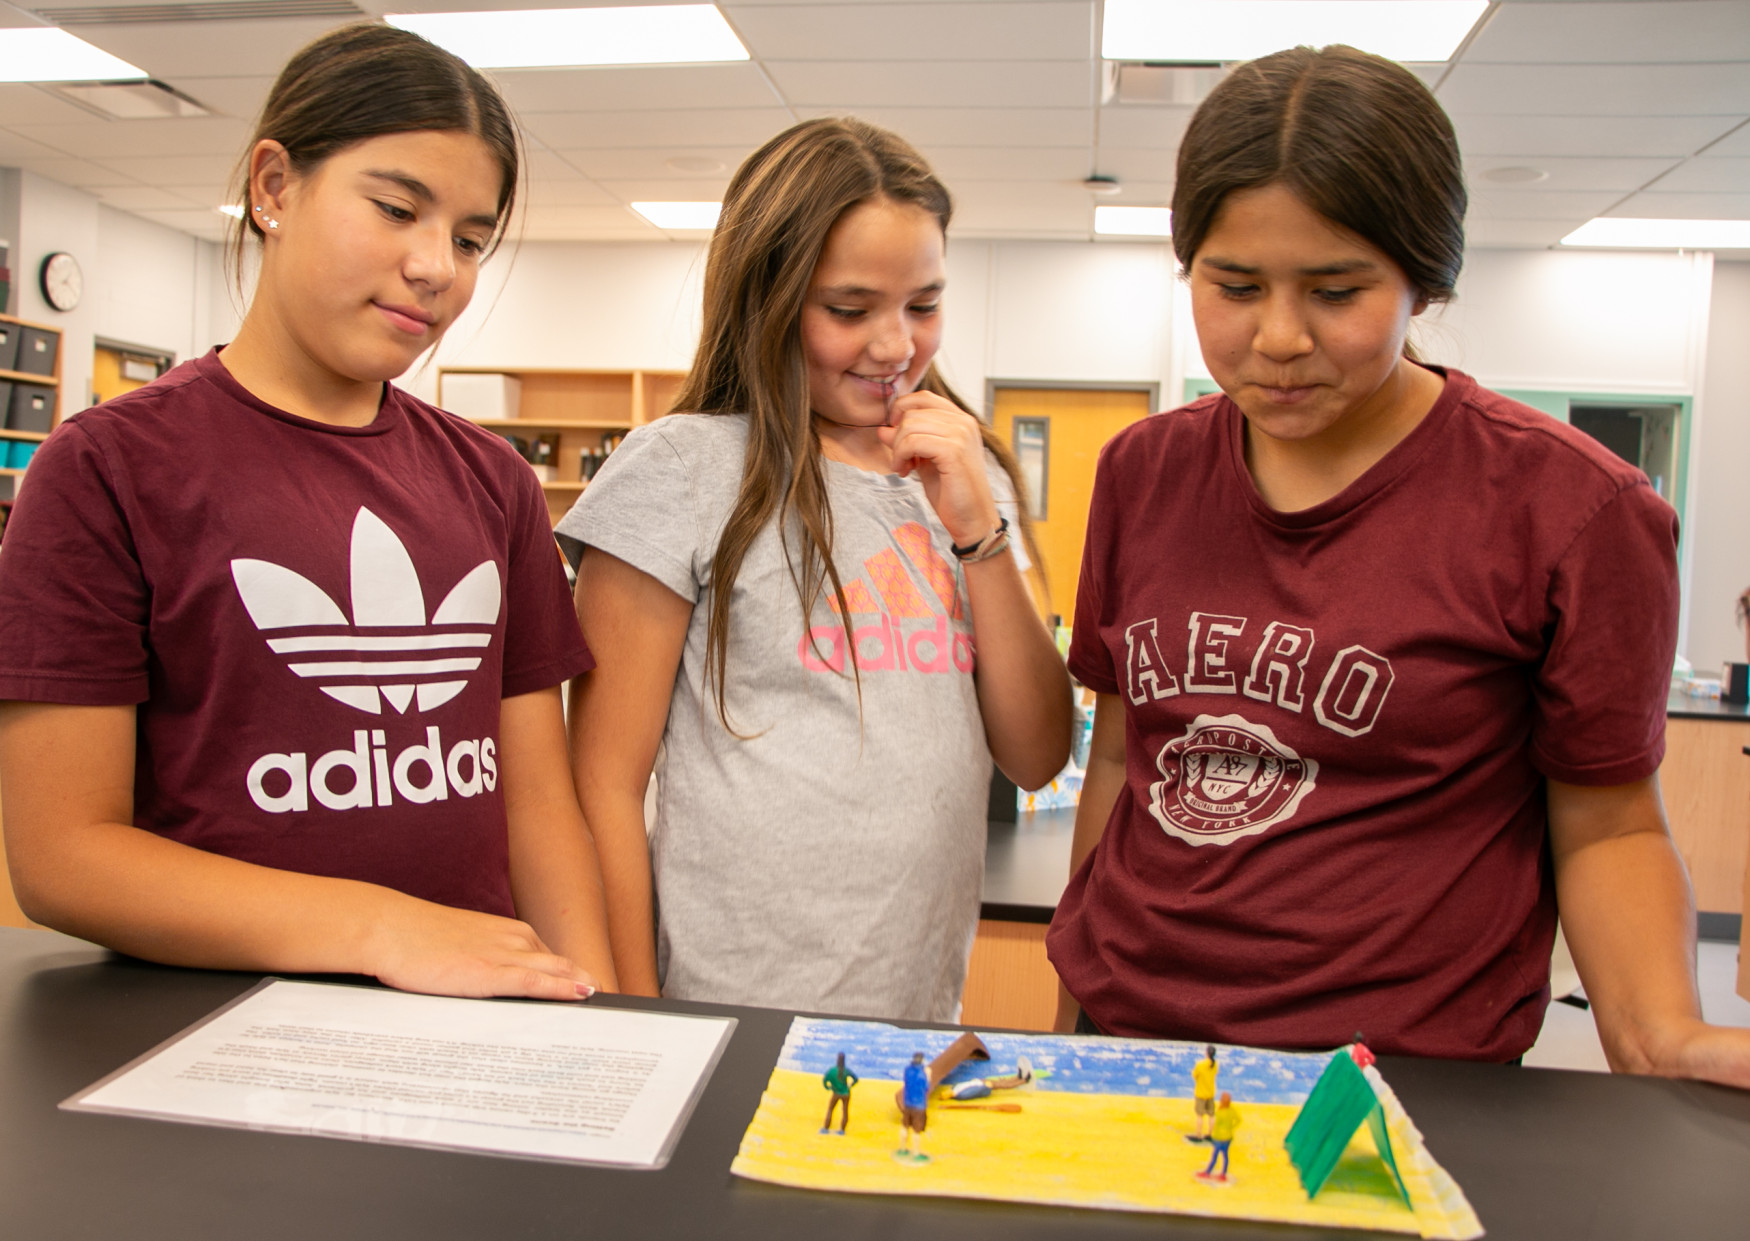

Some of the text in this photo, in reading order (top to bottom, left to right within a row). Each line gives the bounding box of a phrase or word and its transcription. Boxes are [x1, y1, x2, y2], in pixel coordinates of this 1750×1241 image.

[797, 611, 976, 674] adida
[1125, 611, 1395, 738] AERO
[246, 725, 498, 814] adidas
[1208, 782, 1231, 795] NYC
[1189, 797, 1237, 813] ORIGINAL BRAND
[1201, 816, 1252, 829] YORK
